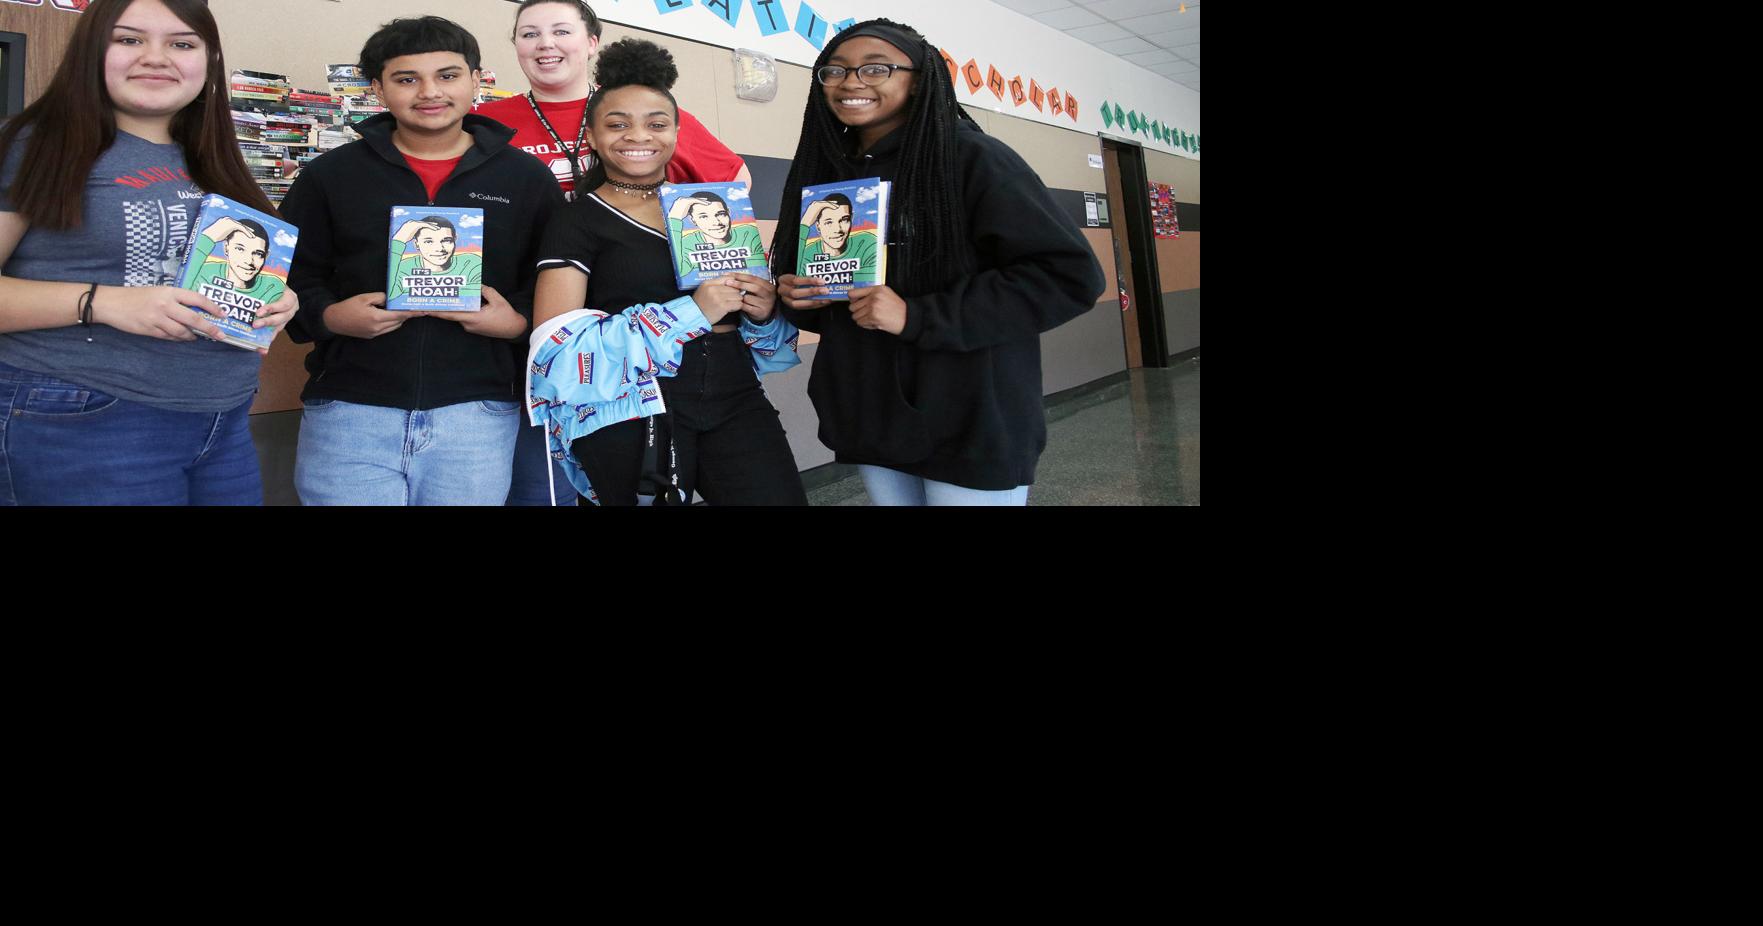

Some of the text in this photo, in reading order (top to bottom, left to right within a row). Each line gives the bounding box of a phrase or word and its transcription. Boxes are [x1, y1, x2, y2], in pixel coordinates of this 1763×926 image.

[477, 193, 510, 204] Columbia
[691, 248, 748, 262] TREVOR
[701, 260, 745, 271] NOAH:
[808, 260, 858, 274] TREVOR
[213, 278, 233, 288] IT'S
[405, 277, 464, 286] TREVOR
[203, 286, 262, 311] TREVOR
[411, 288, 458, 297] NOAH:
[215, 302, 253, 323] OAH:
[583, 353, 591, 384] PLEASURES
